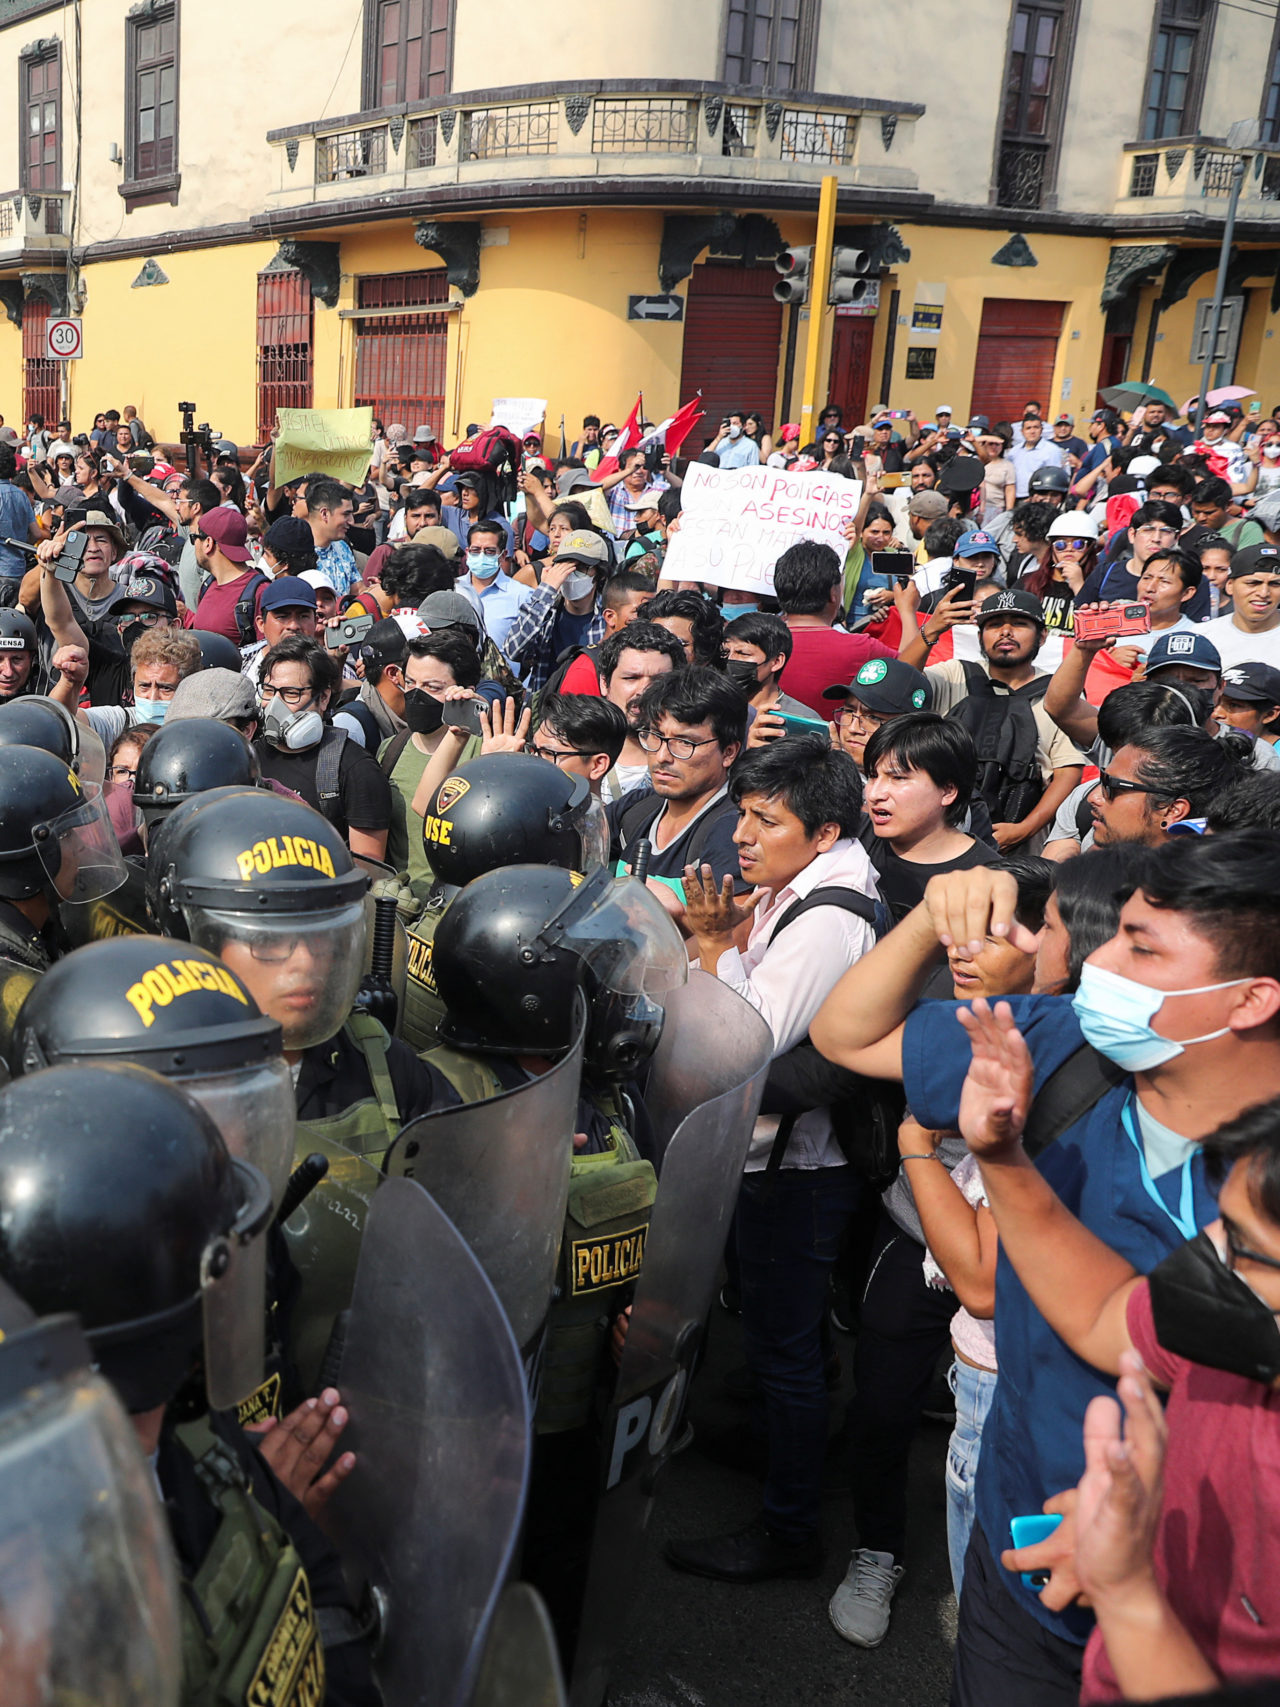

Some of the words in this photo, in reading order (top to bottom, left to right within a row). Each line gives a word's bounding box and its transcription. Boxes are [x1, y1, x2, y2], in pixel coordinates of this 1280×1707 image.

[55, 328, 74, 344] 30
[694, 473, 721, 489] NO
[724, 473, 768, 491] SON
[741, 500, 853, 535] ASESINOS
[424, 815, 454, 846] USE
[236, 835, 337, 881] POLICIA
[577, 1234, 643, 1287] POLICIA
